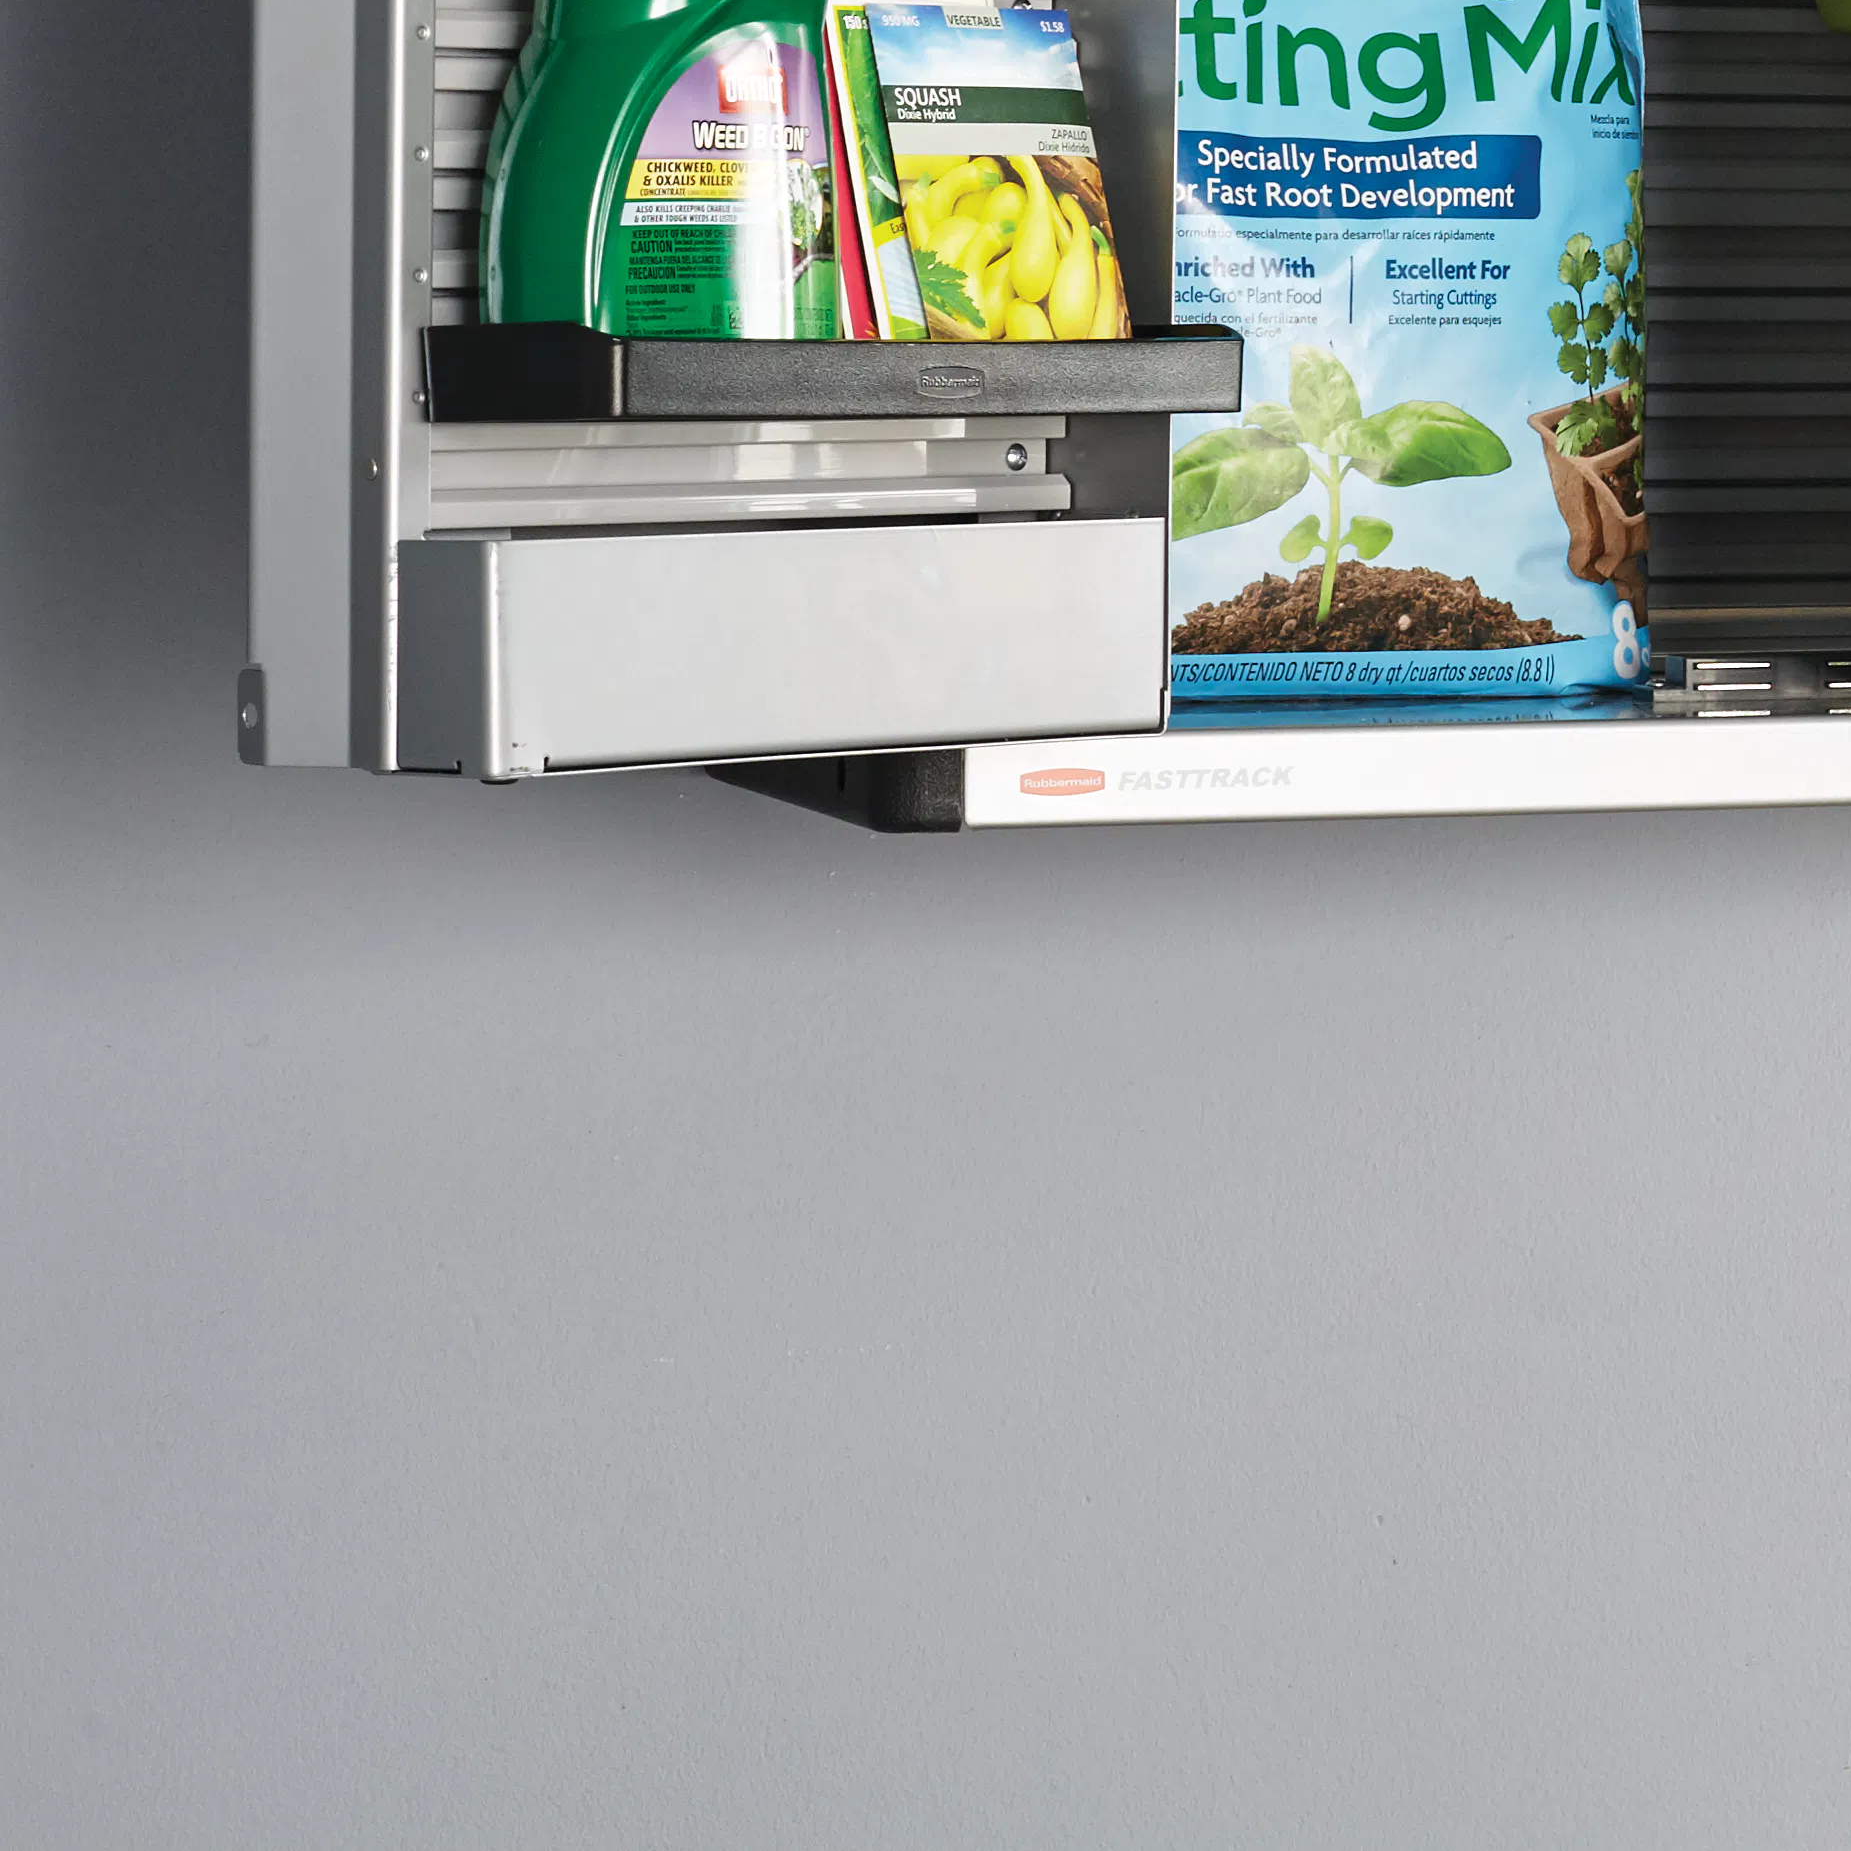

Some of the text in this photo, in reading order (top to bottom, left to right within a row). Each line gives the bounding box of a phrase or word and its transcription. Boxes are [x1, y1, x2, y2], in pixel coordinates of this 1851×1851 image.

[843, 15, 861, 30] 150
[902, 15, 920, 27] MG
[947, 15, 1001, 27] VEGETABLE
[1040, 20, 1064, 33] $1.58
[725, 75, 782, 103] ORTHO
[894, 87, 962, 108] SQUASH
[897, 108, 956, 121] Dixie Hybrid
[692, 121, 749, 150] WEED
[753, 123, 767, 149] B
[1052, 129, 1087, 141] ZAPALLO
[1038, 141, 1059, 152] Dixie
[1198, 139, 1477, 178] Specially Formulated
[647, 161, 716, 173] CHICKWEED,
[643, 176, 733, 186] & OXALIS KILLER
[640, 188, 686, 197] CONCENTRATE
[1176, 171, 1515, 215] or Fast Root Development
[636, 205, 730, 214] ALSO KILLS CREEPING CHARLIE
[634, 215, 737, 223] & OTHER TOUGH WEEDS AS LISTED
[632, 230, 651, 238] KEEP
[653, 230, 669, 238] OUT
[671, 229, 680, 238] OF
[680, 230, 704, 238] REACH
[705, 230, 714, 238] OF
[1176, 227, 1495, 243] ormulado especialmente para desarrollar raíces rápidamente
[631, 241, 673, 253] CAUTION
[1176, 256, 1315, 278] nriched With
[1386, 258, 1510, 280] Excellent For
[625, 284, 696, 294] FOR OUTDOOR USE ONLY
[1247, 288, 1283, 304] Plant
[1286, 289, 1322, 304] Food
[1392, 289, 1497, 310] Starting Cuttings
[1174, 313, 1318, 324] quecida con el fertilizante
[1388, 315, 1502, 328] Excelente para esquejes
[1612, 600, 1641, 680] 8
[1300, 661, 1343, 682] NETO
[1346, 662, 1357, 681] 8
[1358, 662, 1384, 685] dry
[1386, 663, 1402, 685] qt
[1469, 665, 1514, 682] secos
[1024, 765, 1296, 791] Rubbermaid FASTTRACK
